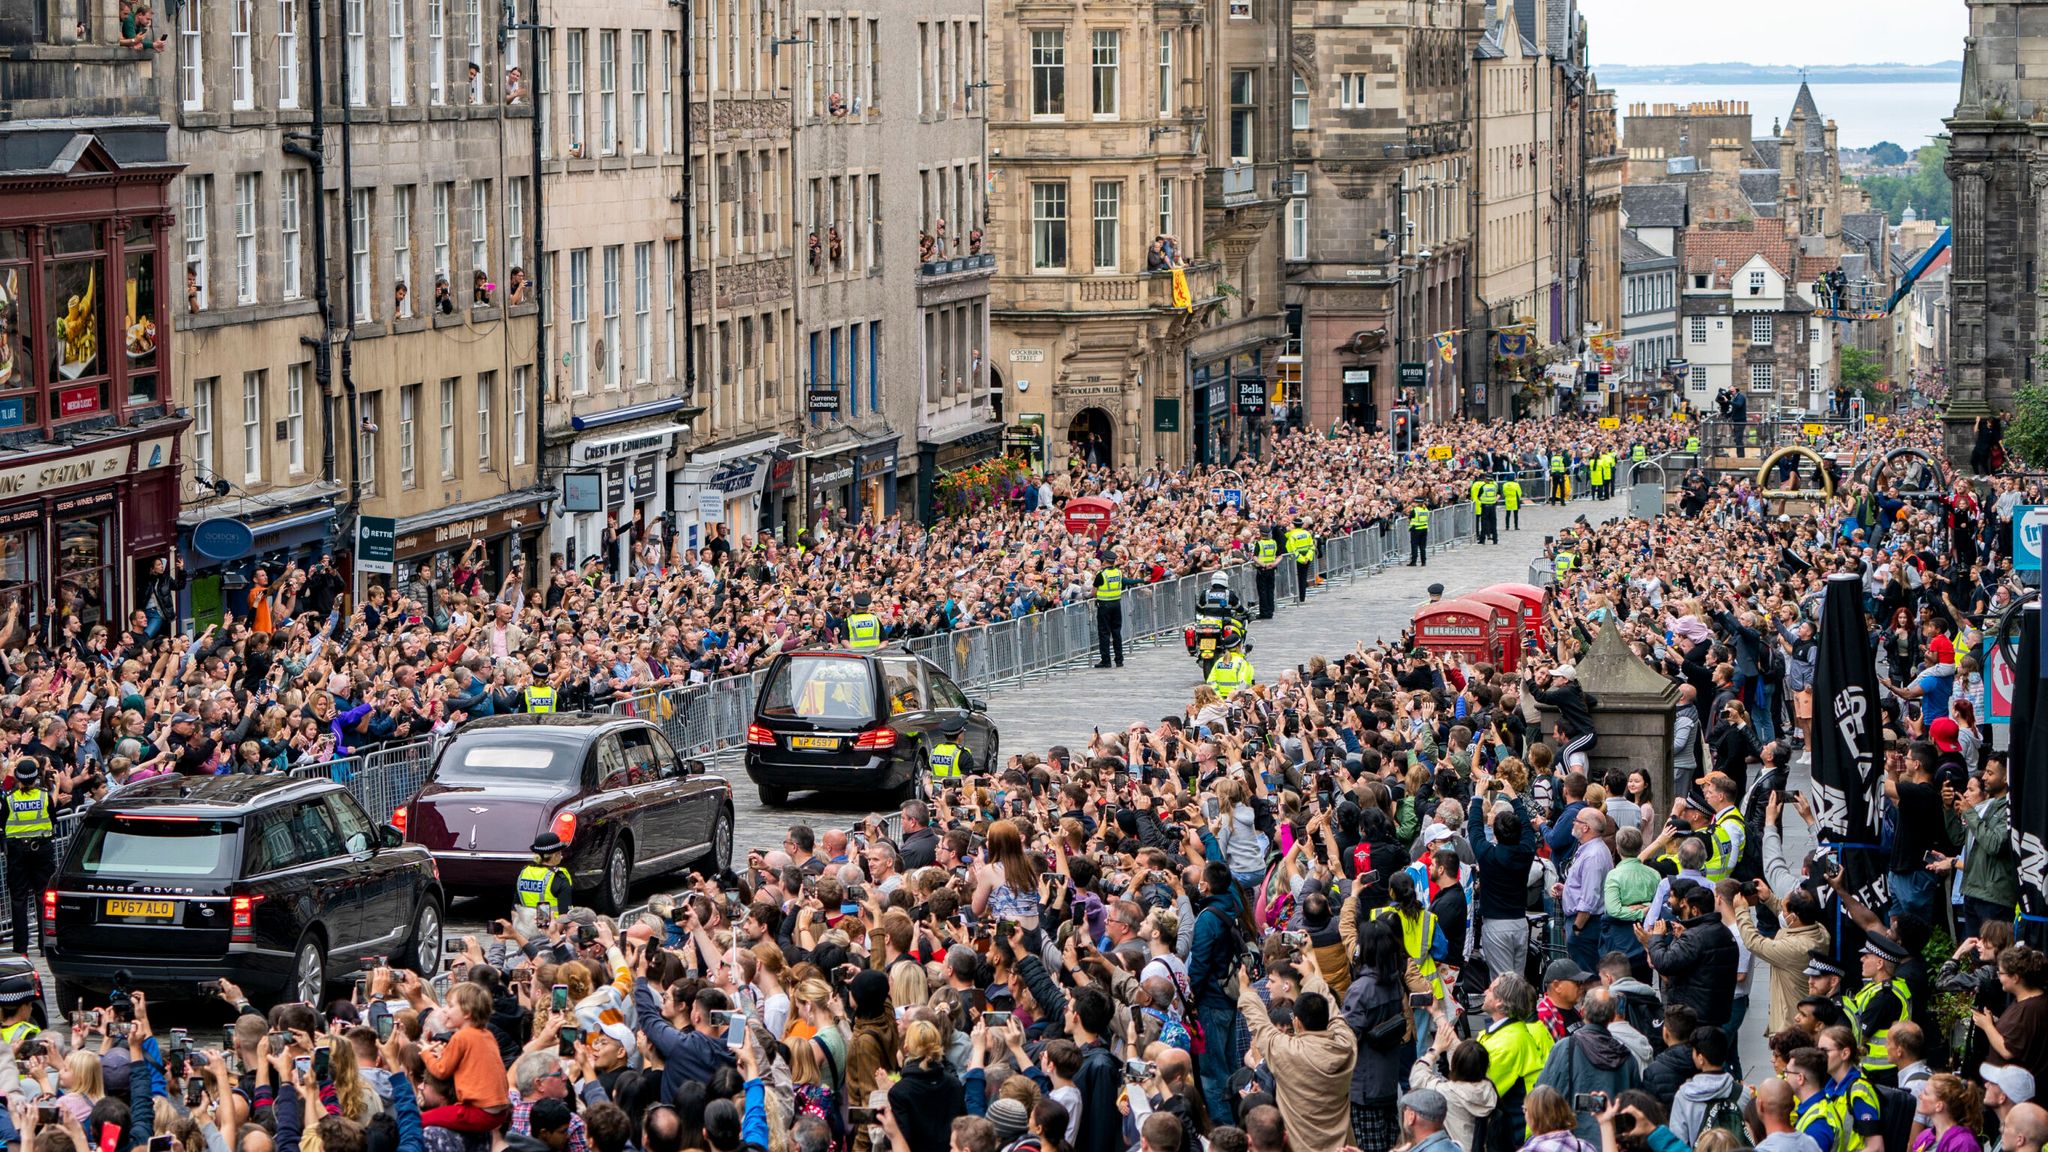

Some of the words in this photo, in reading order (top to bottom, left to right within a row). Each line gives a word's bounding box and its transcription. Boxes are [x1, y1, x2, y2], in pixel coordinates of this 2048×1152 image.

[1402, 368, 1423, 376] BYRON
[1087, 375, 1101, 383] THE
[1102, 386, 1120, 394] MILL
[1240, 383, 1264, 394] Bella
[810, 394, 838, 402] Currency
[1240, 394, 1264, 405] Italia
[584, 444, 609, 460] CREST
[609, 442, 620, 455] OF
[37, 459, 96, 489] STATION
[822, 471, 838, 483] Currency
[837, 467, 854, 479] Exchange
[57, 501, 74, 512] BEERS
[76, 498, 93, 508] WINES
[95, 492, 113, 504] SPIRITS
[14, 510, 39, 522] BURGERS
[370, 530, 393, 539] RETTIE
[434, 526, 448, 543] The
[448, 520, 473, 539] Whisky
[472, 516, 488, 533] Trail
[1427, 626, 1477, 635] TELEPHONE
[531, 698, 552, 706] POLICE
[932, 755, 952, 765] POLICE
[14, 801, 42, 811] POLICE
[87, 884, 135, 893] RANGE
[520, 880, 542, 892] POLICE
[111, 901, 143, 913] PV67
[146, 902, 169, 914] ALO
